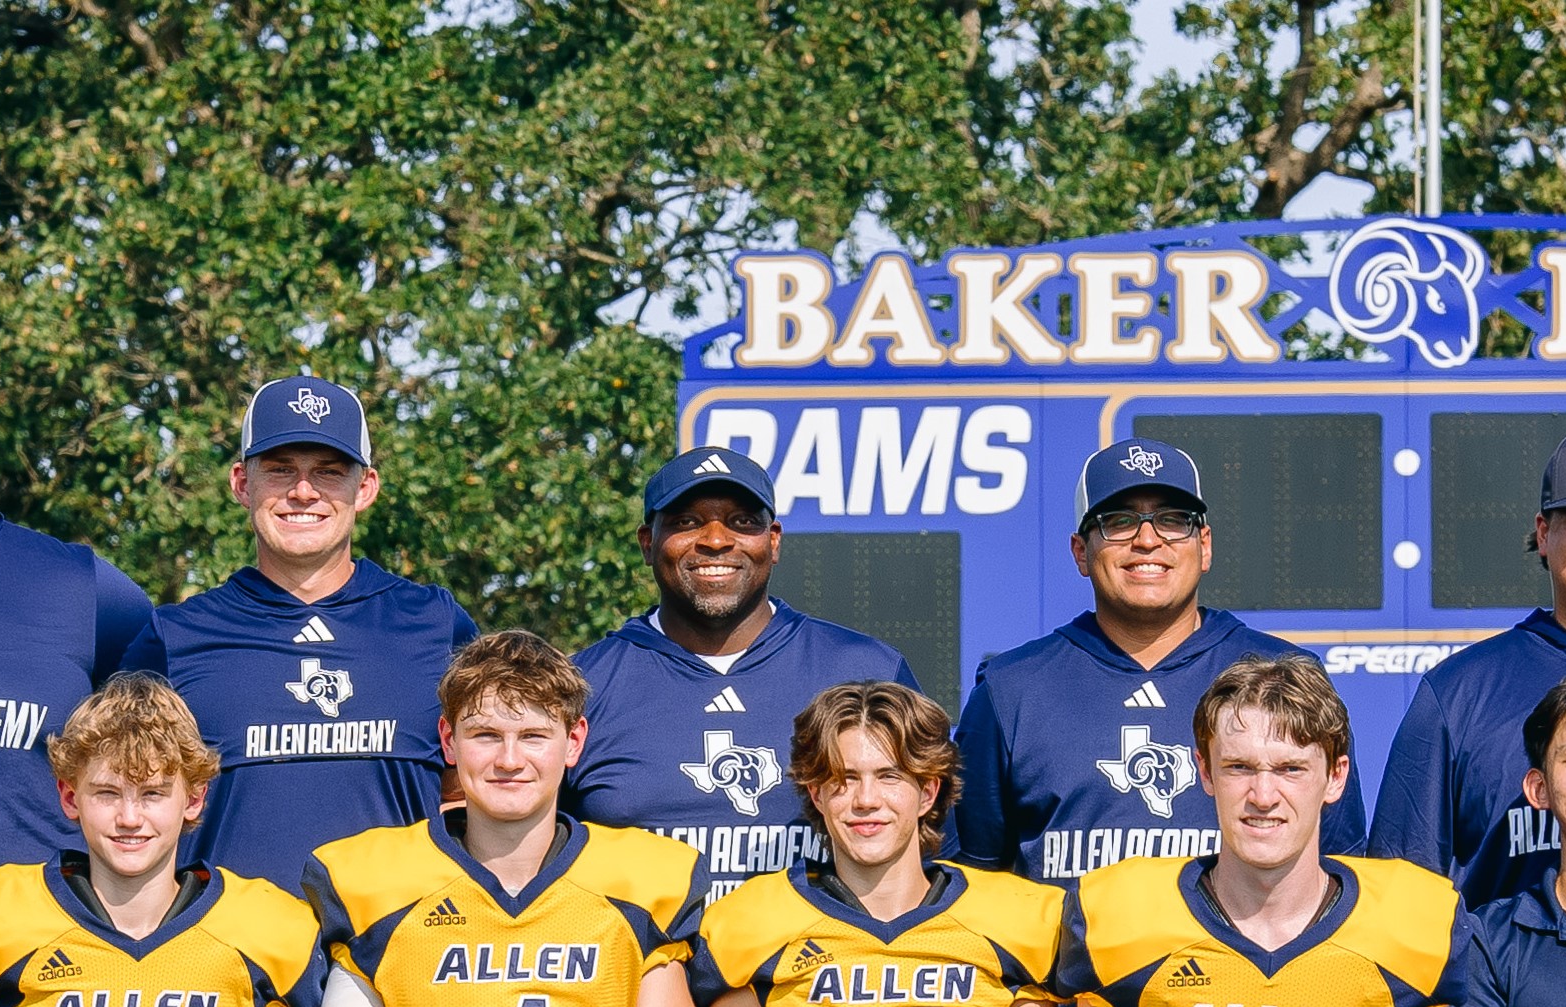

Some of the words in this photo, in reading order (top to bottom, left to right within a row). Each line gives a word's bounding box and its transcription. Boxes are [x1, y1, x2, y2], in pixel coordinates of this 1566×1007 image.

[735, 249, 1283, 368] BAKER
[246, 724, 306, 758] ALLEN
[307, 719, 397, 754] ACADEMY
[1043, 828, 1122, 879] ALLEN
[423, 914, 466, 927] adidas
[37, 965, 83, 982] adidas
[432, 943, 600, 984] ALLEN
[791, 952, 835, 973] adidas
[1166, 975, 1211, 988] adidas
[807, 963, 977, 1004] ALLEN
